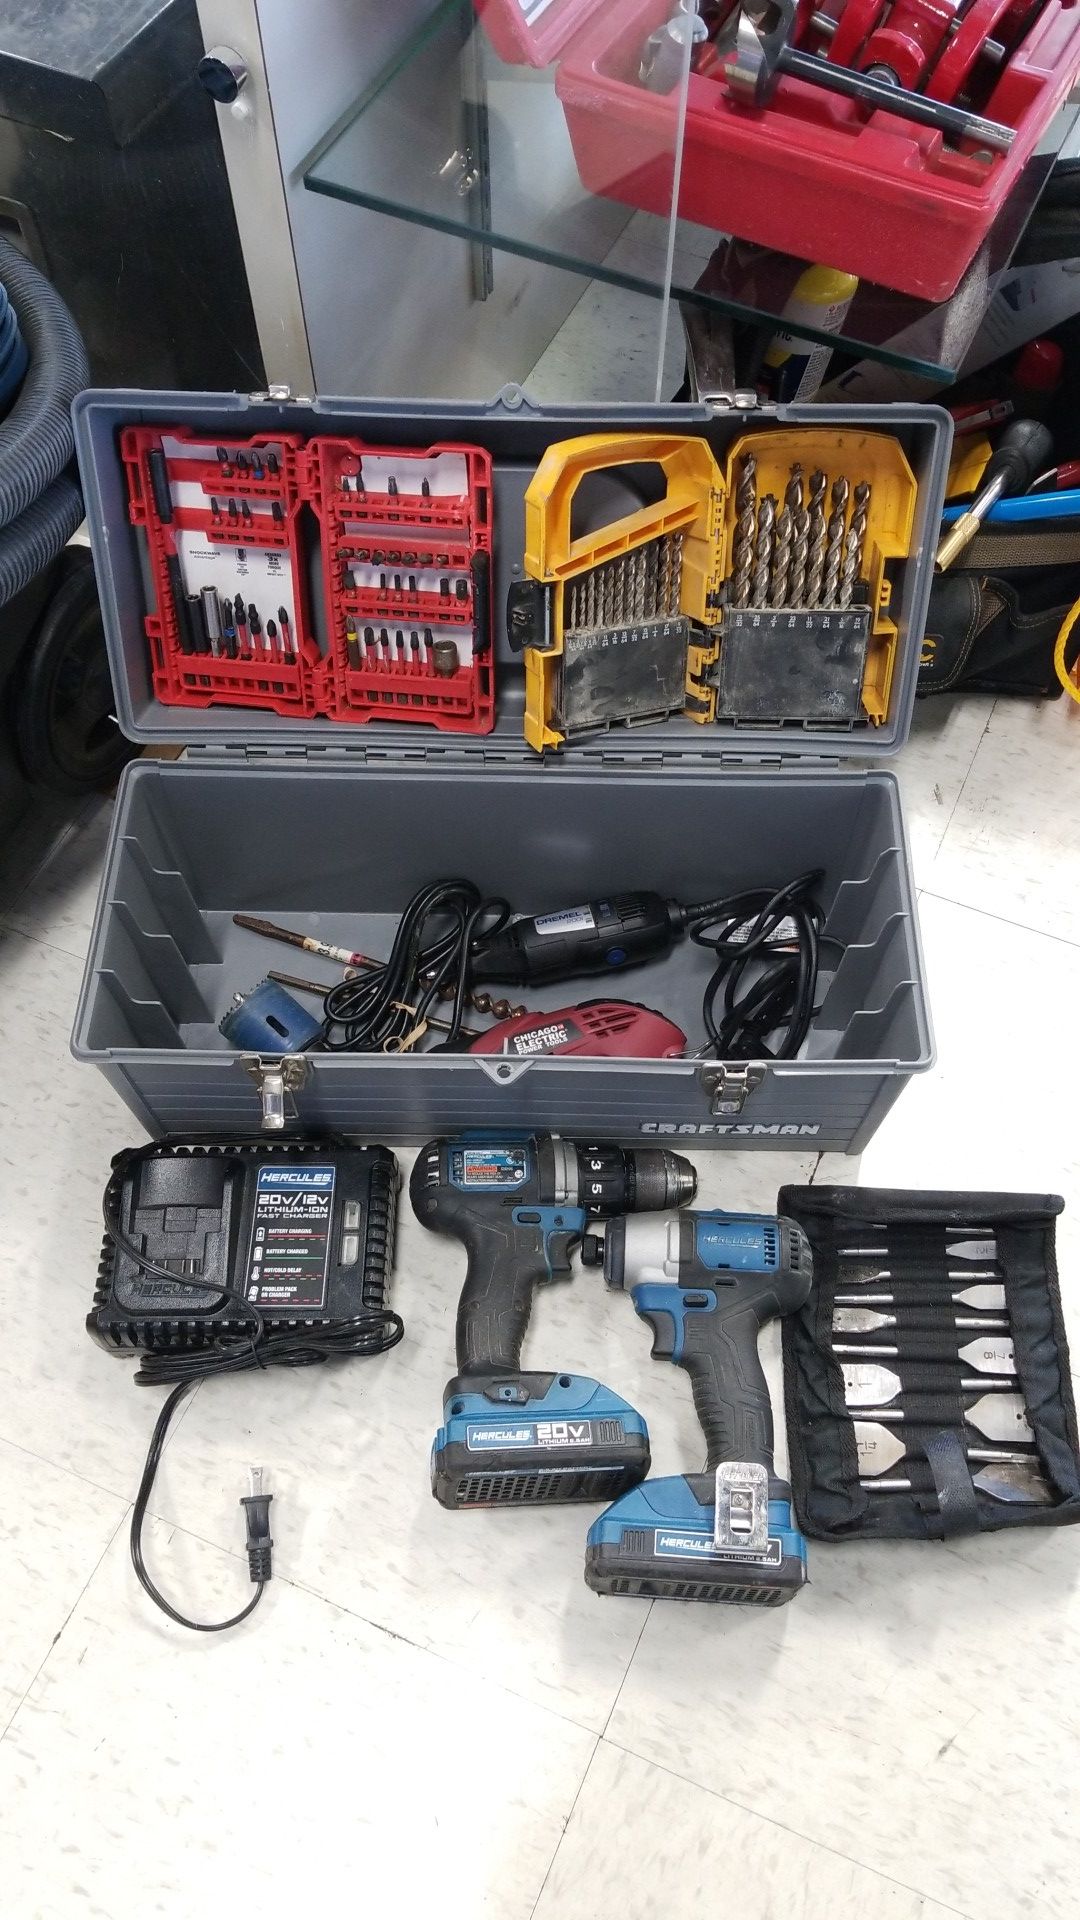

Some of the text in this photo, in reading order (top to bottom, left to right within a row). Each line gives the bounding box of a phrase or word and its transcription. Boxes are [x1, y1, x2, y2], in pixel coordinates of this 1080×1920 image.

[536, 912, 582, 925] DREMEL
[513, 1025, 558, 1043] CHICAGO
[516, 1030, 567, 1051] ELECTRIC
[518, 1036, 568, 1055] POWER TOOLS
[640, 1122, 821, 1135] CRAFTSMAN
[590, 1160, 602, 1170] 3
[260, 1173, 332, 1183] HERCULES
[591, 1183, 603, 1194] 5
[590, 1205, 601, 1213] 7
[703, 1235, 762, 1246] HERCULES
[472, 1430, 531, 1441] HERCULES
[660, 1537, 716, 1550] HERCULE
